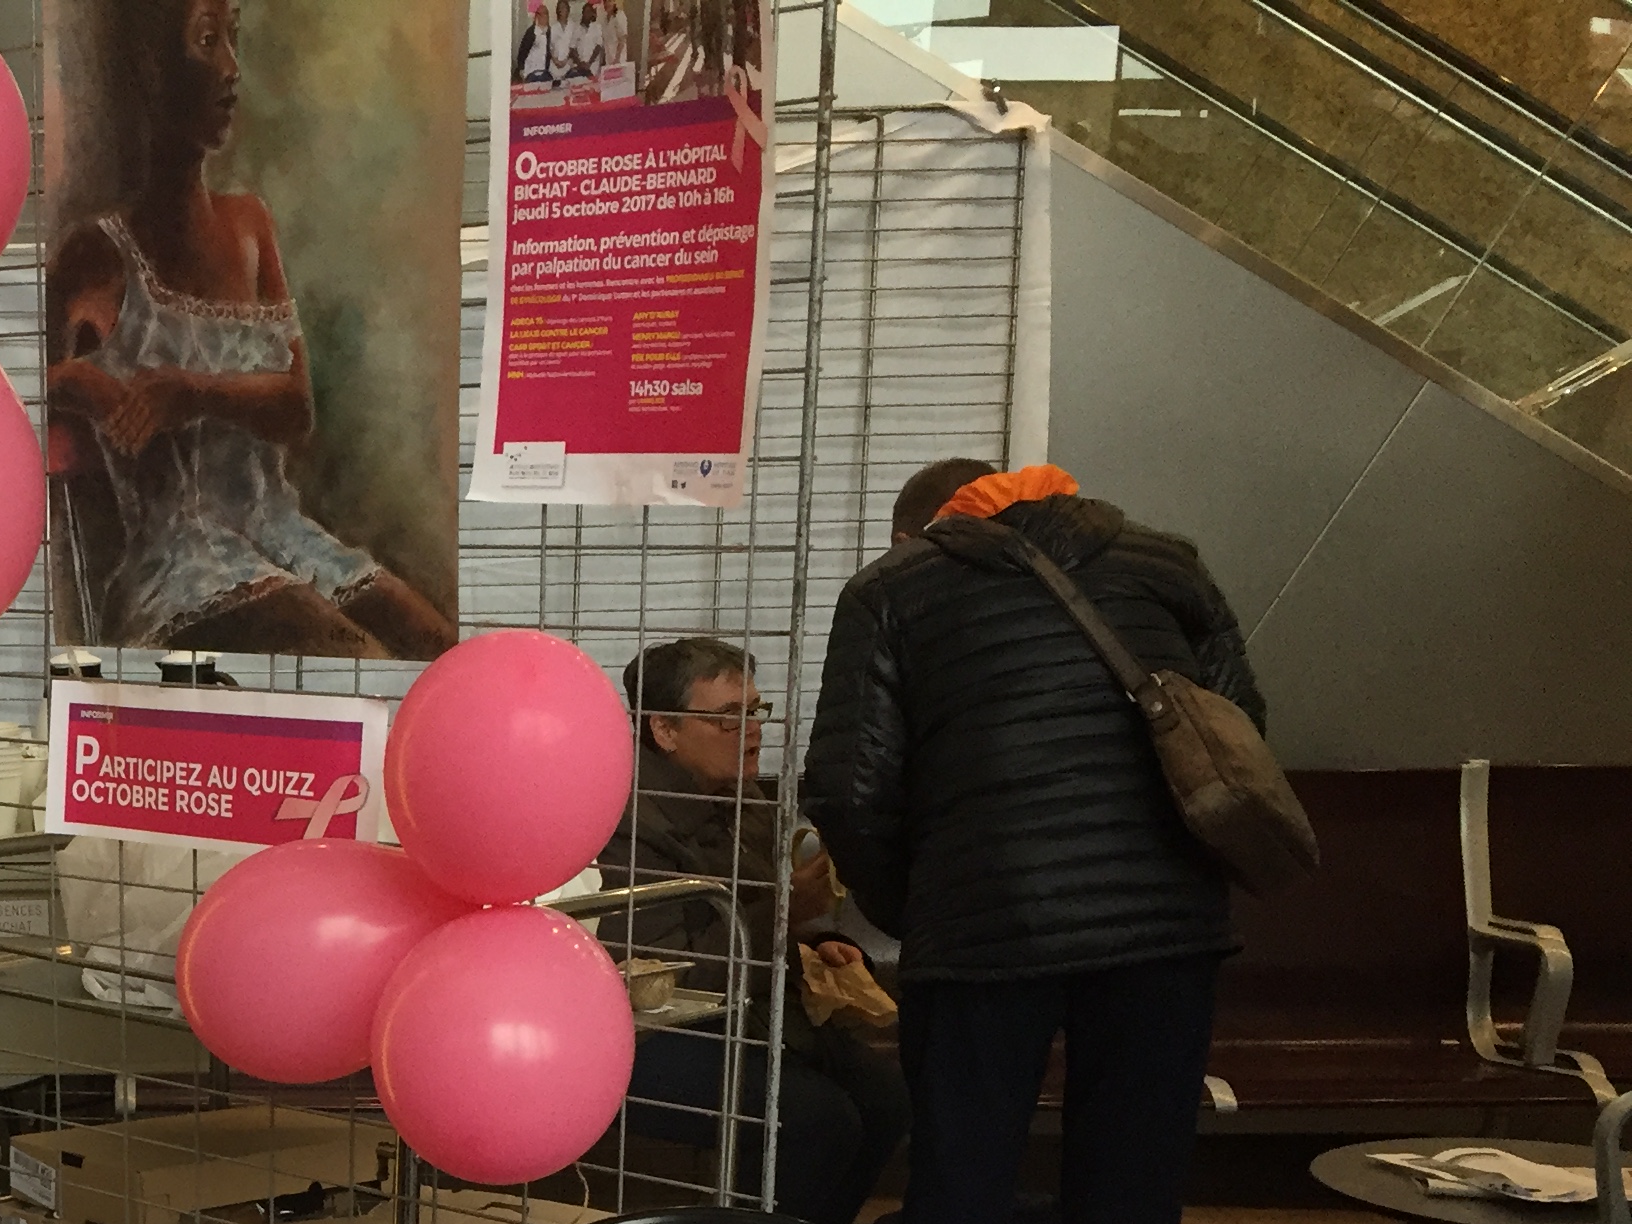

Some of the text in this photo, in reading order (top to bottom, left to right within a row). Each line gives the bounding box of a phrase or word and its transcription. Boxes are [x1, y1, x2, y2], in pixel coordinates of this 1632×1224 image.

[515, 143, 726, 180] OCTOBRE ROSE À L'HÔPITAL
[514, 167, 716, 201] BICHAT CLAUDE-BERNARD
[629, 378, 703, 396] 14h30 salsa
[75, 734, 314, 796] PARTICIPEZ AU QUIZZ
[72, 779, 232, 817] OCTOBRE ROSE
